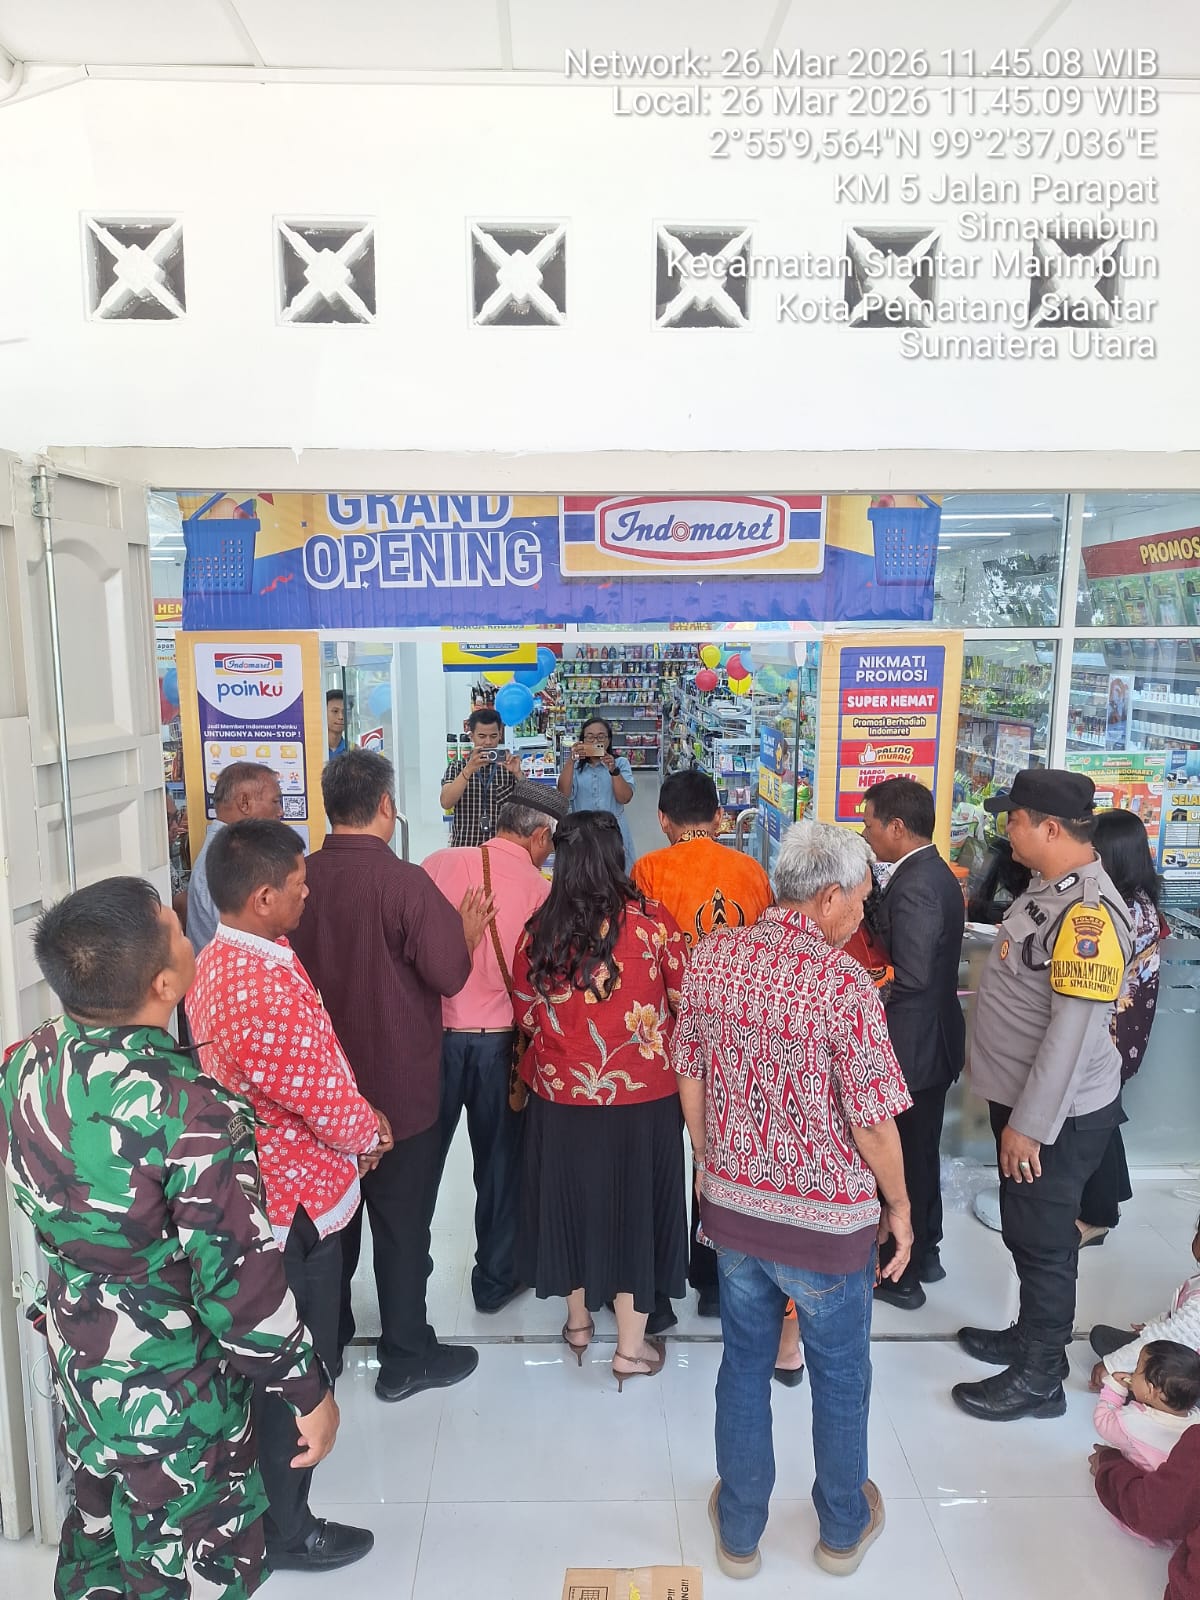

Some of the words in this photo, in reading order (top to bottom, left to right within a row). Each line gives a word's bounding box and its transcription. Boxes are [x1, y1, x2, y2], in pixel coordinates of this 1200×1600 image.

[326, 494, 514, 530] GRAND
[610, 509, 775, 543] Indomaret
[303, 531, 543, 590] OPENING
[226, 660, 272, 669] Indomaret
[859, 655, 926, 668] NIKMATI
[855, 669, 928, 682] PROMOSI
[217, 680, 283, 702] poinku
[847, 695, 888, 708] SUPER
[890, 694, 935, 707] HEMAT
[853, 718, 885, 728] Promosi
[886, 716, 926, 727] Berhadiah
[203, 730, 254, 738] UNTUNGNYA
[254, 730, 297, 738] NON-STOP
[868, 727, 910, 736] Indomaret
